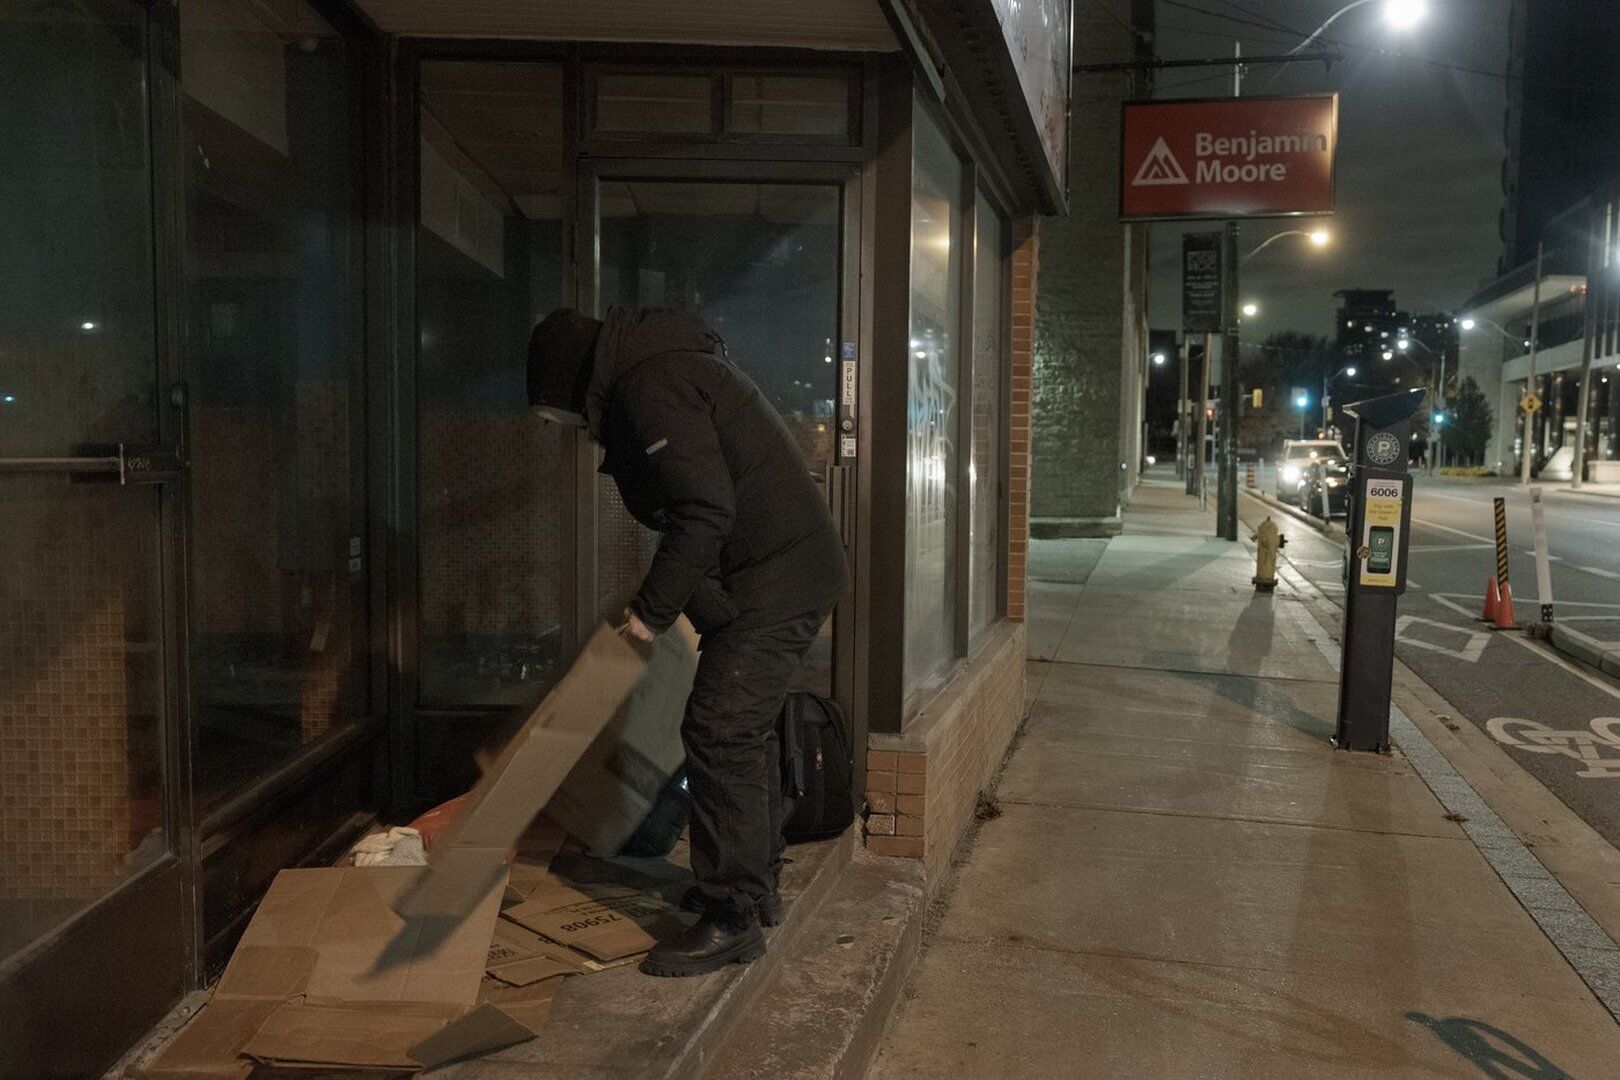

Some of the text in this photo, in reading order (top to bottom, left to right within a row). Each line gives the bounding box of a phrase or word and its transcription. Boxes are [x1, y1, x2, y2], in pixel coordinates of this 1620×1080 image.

[1195, 129, 1327, 160] Benjamin
[1195, 160, 1286, 183] Moore
[1370, 487, 1398, 498] 6006
[560, 914, 623, 932] 75908
